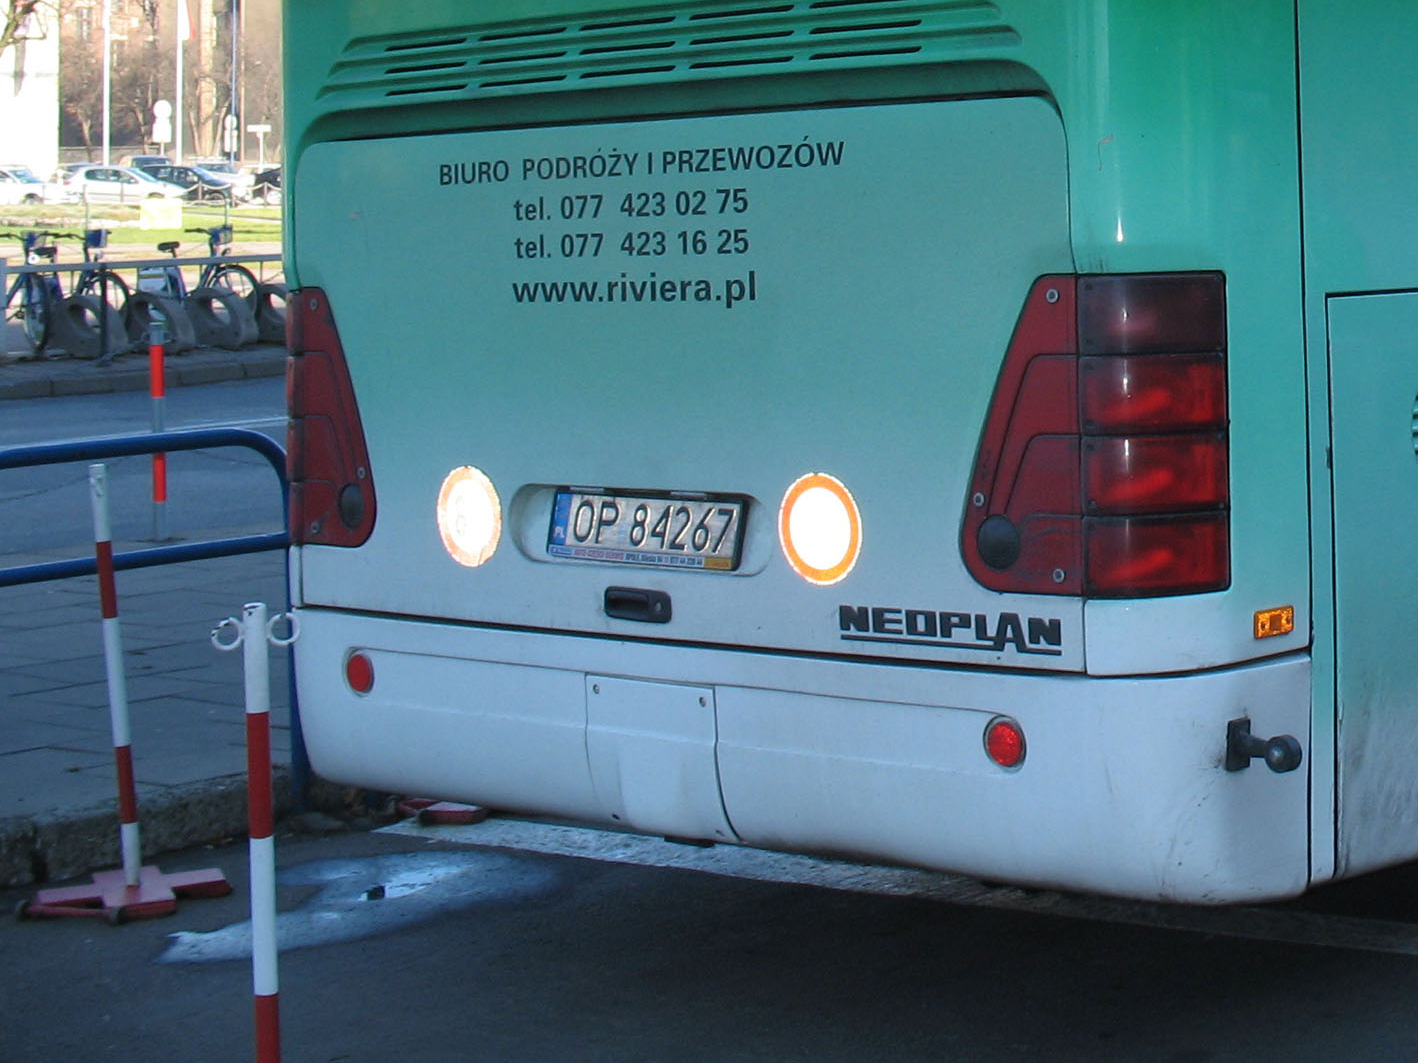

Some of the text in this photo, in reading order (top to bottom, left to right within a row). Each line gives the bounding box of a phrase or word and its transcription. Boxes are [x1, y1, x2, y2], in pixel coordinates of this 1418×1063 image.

[439, 135, 845, 186] BIURO PODRÓŻY I PRZEWOZÓW
[513, 188, 749, 221] tel. 077 423 02 75
[513, 229, 750, 259] tel. 077 423 16 25
[512, 270, 757, 308] www.riviera.pl
[573, 500, 738, 554] OP 84267
[838, 604, 1063, 657] NEOPLAN
